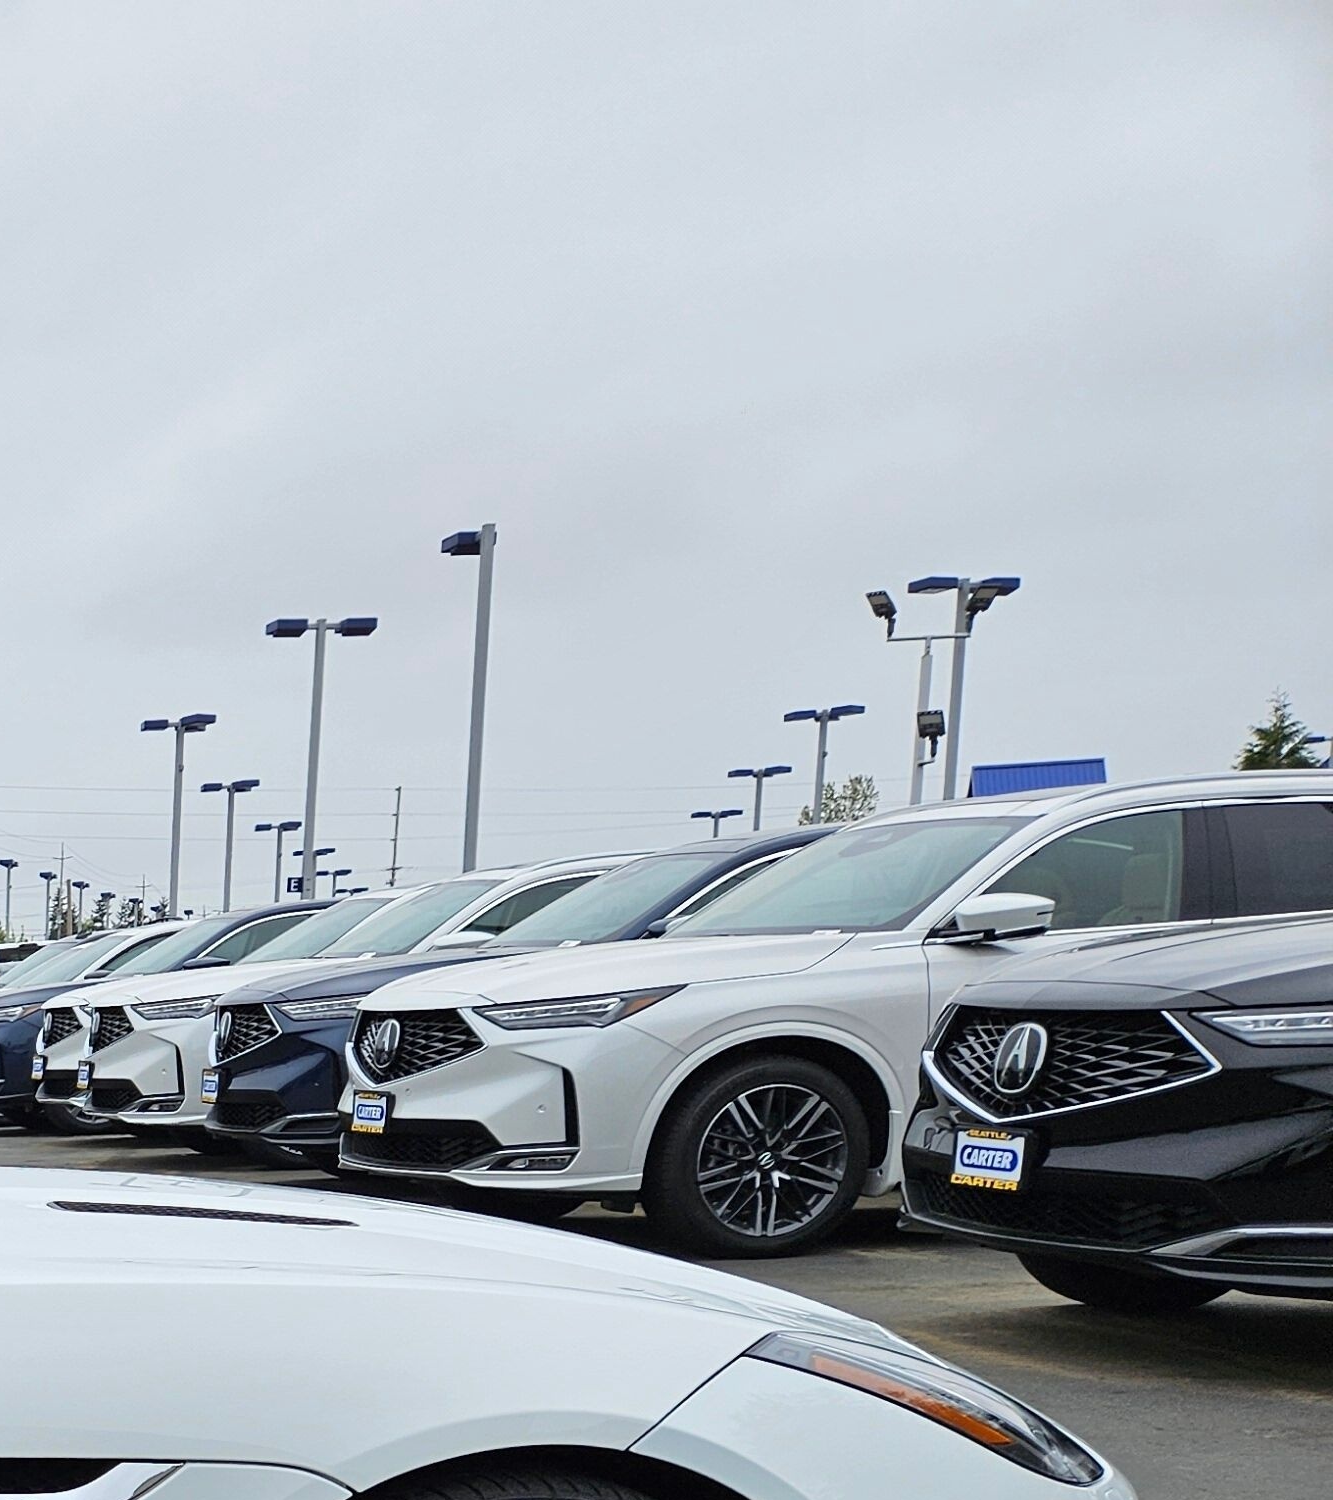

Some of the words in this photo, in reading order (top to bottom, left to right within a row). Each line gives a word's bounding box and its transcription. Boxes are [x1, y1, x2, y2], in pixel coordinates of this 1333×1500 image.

[290, 879, 299, 891] E
[969, 1129, 1008, 1139] SEATTLE
[962, 1147, 1014, 1169] CARTER
[950, 1174, 1019, 1191] CARTER
